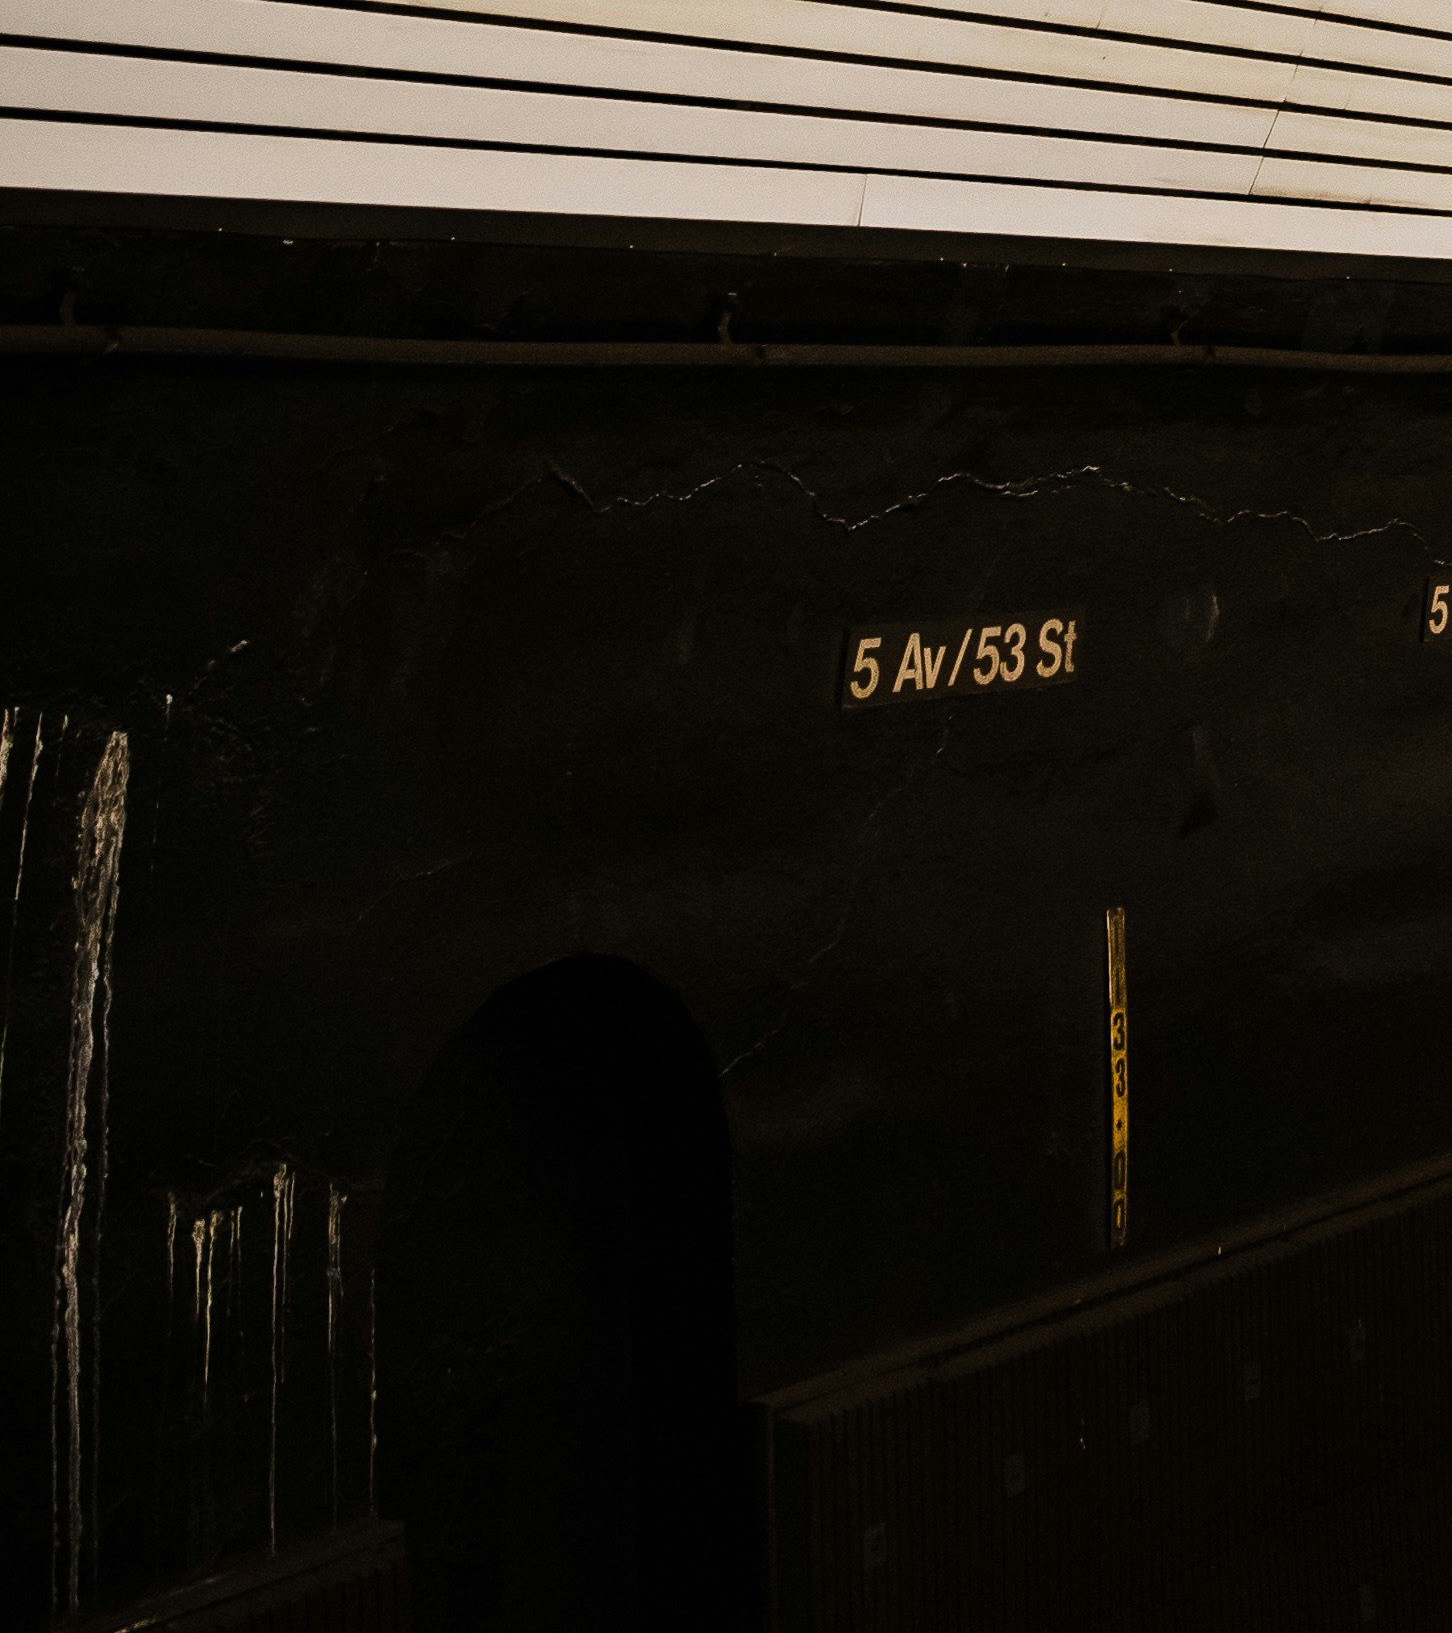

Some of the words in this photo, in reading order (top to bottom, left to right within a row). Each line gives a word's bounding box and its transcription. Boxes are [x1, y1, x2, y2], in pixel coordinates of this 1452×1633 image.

[1429, 585, 1449, 634] 5
[850, 637, 881, 699] 5
[1036, 618, 1077, 678] St
